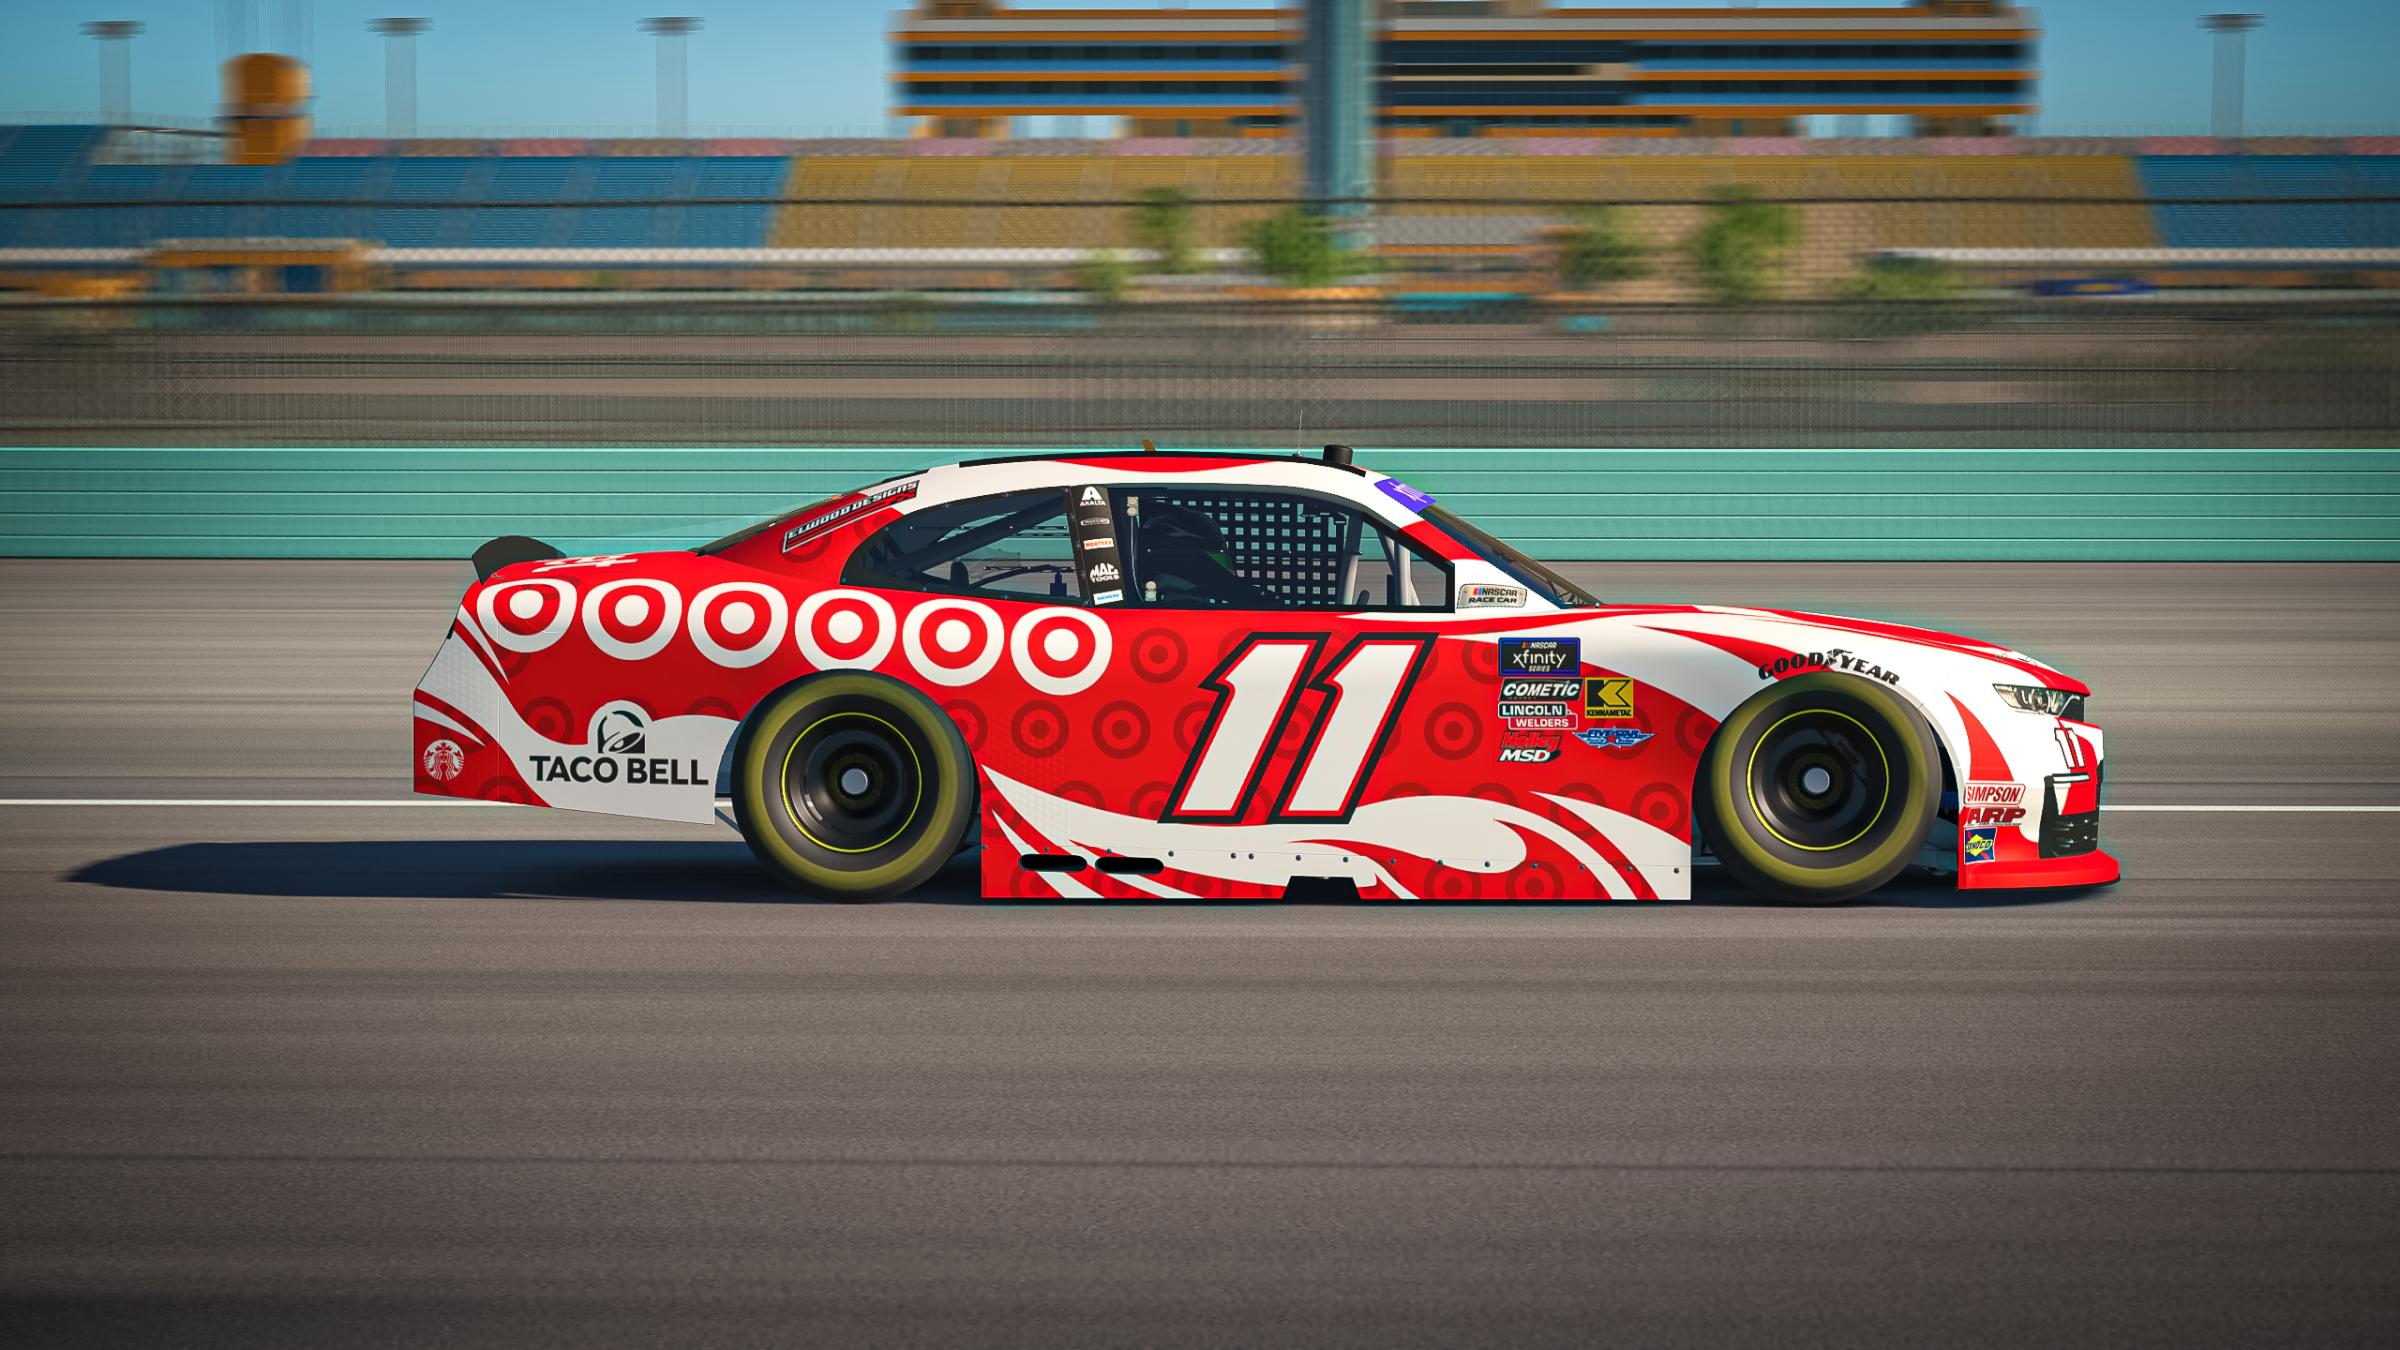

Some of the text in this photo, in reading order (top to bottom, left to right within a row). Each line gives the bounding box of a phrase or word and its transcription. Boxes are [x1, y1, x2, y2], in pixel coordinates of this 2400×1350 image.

[788, 481, 918, 539] ELWOOD DESIGNS
[1090, 562, 1119, 577] MAC
[1091, 574, 1120, 583] TOOLS
[1482, 587, 1518, 597] NASCAR
[1530, 641, 1558, 649] NASCAR
[1513, 649, 1566, 669] xfinity
[1503, 680, 1580, 697] COMETIC
[1502, 705, 1563, 716] LINCOLN
[1586, 709, 1632, 717] KENNAMETAL
[1157, 632, 1440, 824] 11
[1515, 718, 1569, 728] WELDERS
[1500, 731, 1561, 753] Holley
[2054, 727, 2087, 769] 11
[1499, 749, 1551, 762] MSD
[529, 755, 709, 785] TACO BELL
[1967, 786, 2021, 802] SIMPSON
[1967, 808, 2026, 824] ARP
